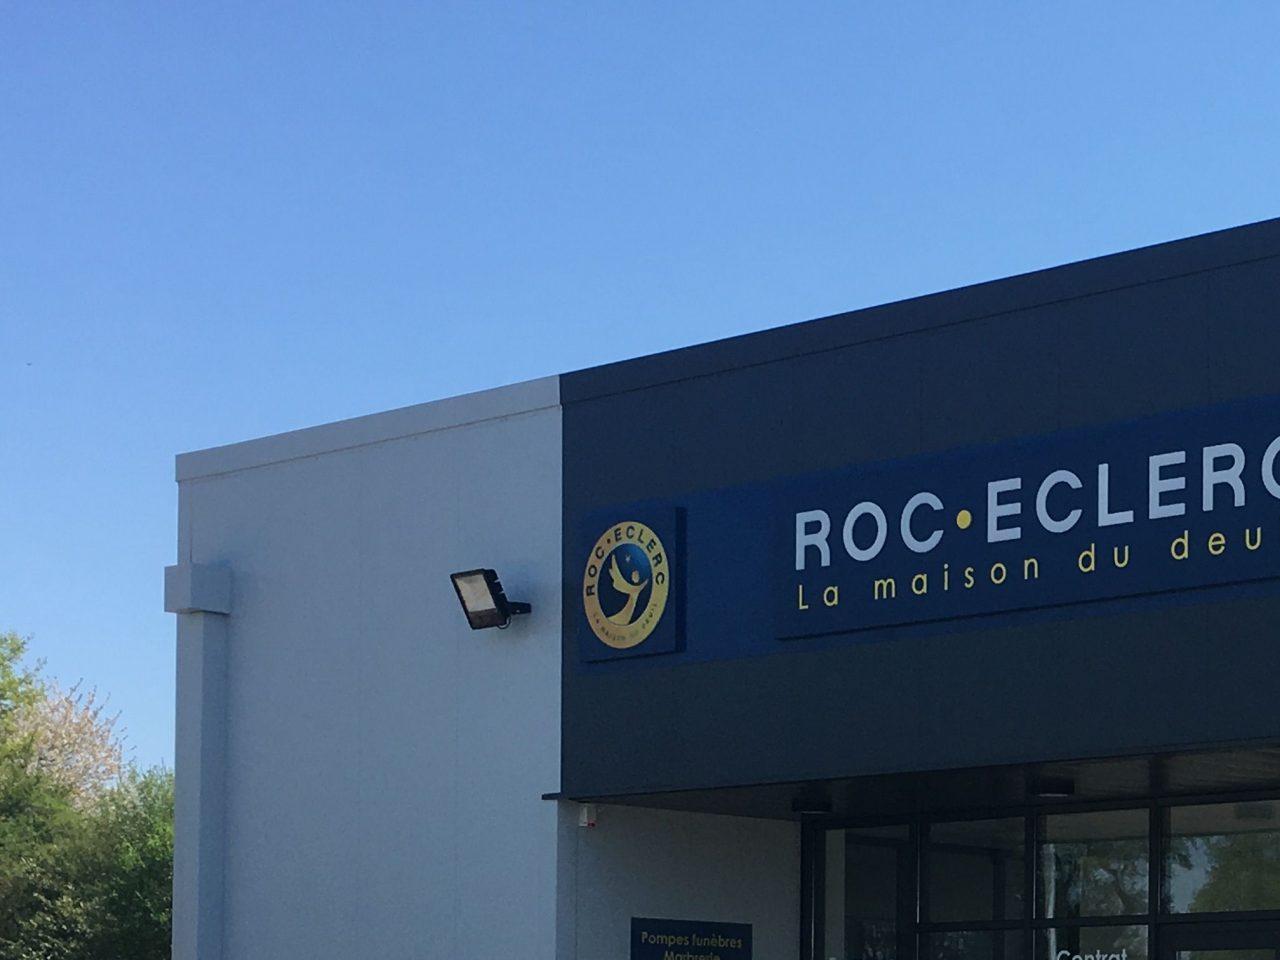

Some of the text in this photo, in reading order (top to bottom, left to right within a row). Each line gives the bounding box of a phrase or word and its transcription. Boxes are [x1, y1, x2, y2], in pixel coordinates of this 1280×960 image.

[798, 584, 839, 610] La
[874, 557, 1039, 600] maison
[1078, 542, 1129, 572] du
[641, 931, 743, 949] Pompes funèbres
